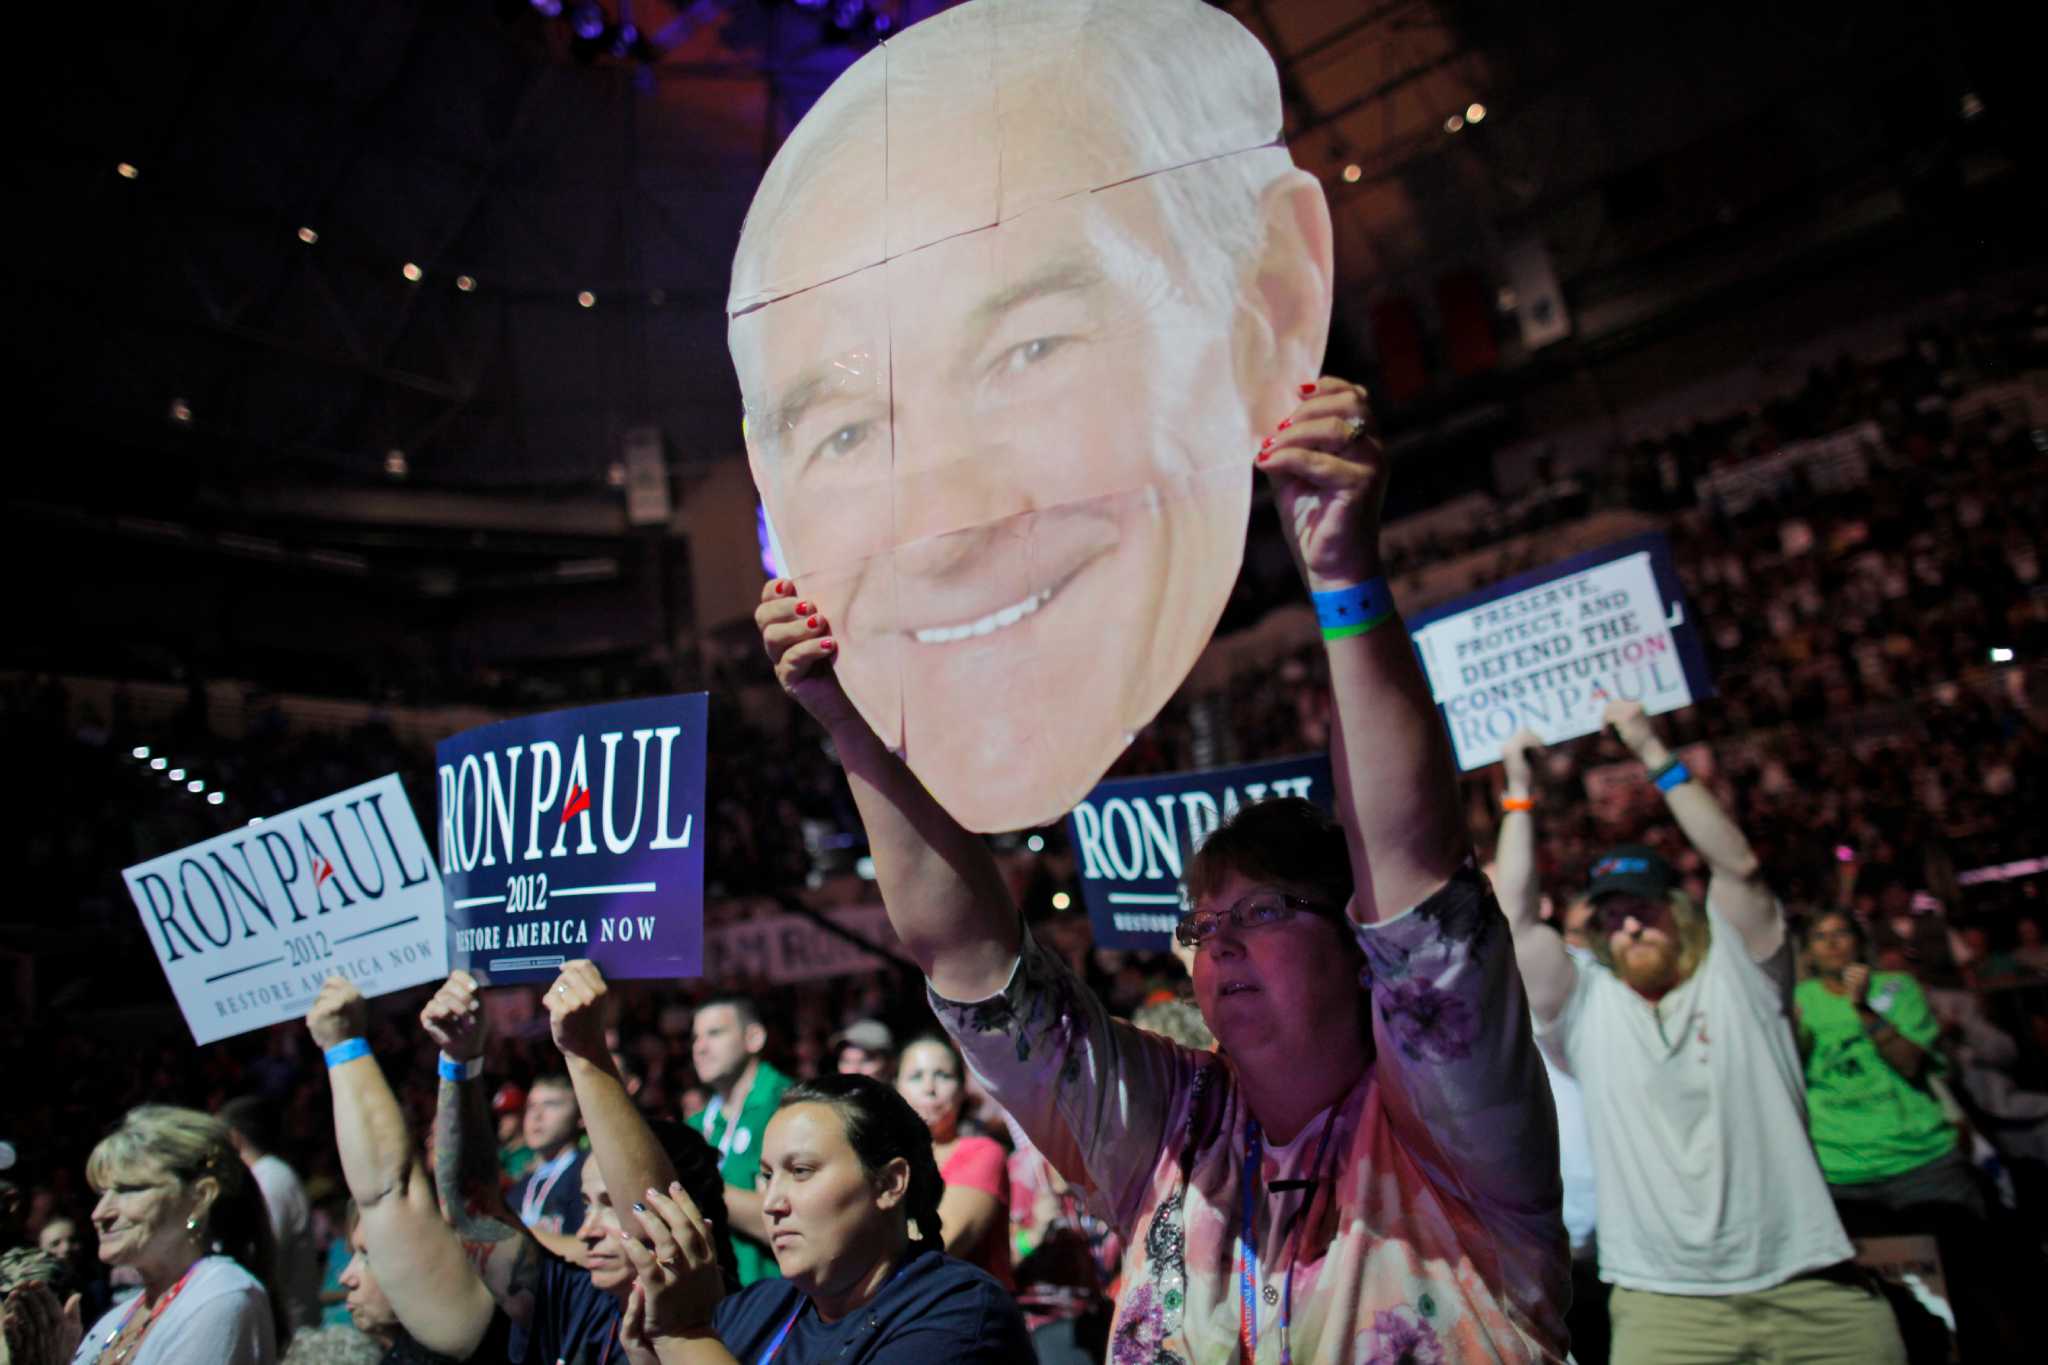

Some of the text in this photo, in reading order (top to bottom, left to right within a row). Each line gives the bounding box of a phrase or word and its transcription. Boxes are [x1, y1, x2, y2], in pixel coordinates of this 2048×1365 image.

[1578, 588, 1631, 621] AND
[1460, 609, 1641, 686] DEFEND THE
[1450, 632, 1667, 717] CONSTITUTION
[505, 872, 548, 914] 2012
[283, 930, 334, 967] 2012
[505, 919, 588, 949] AMERICA
[600, 916, 656, 943] NOW
[215, 982, 293, 1015] RESTORE
[389, 938, 434, 969] NOW
